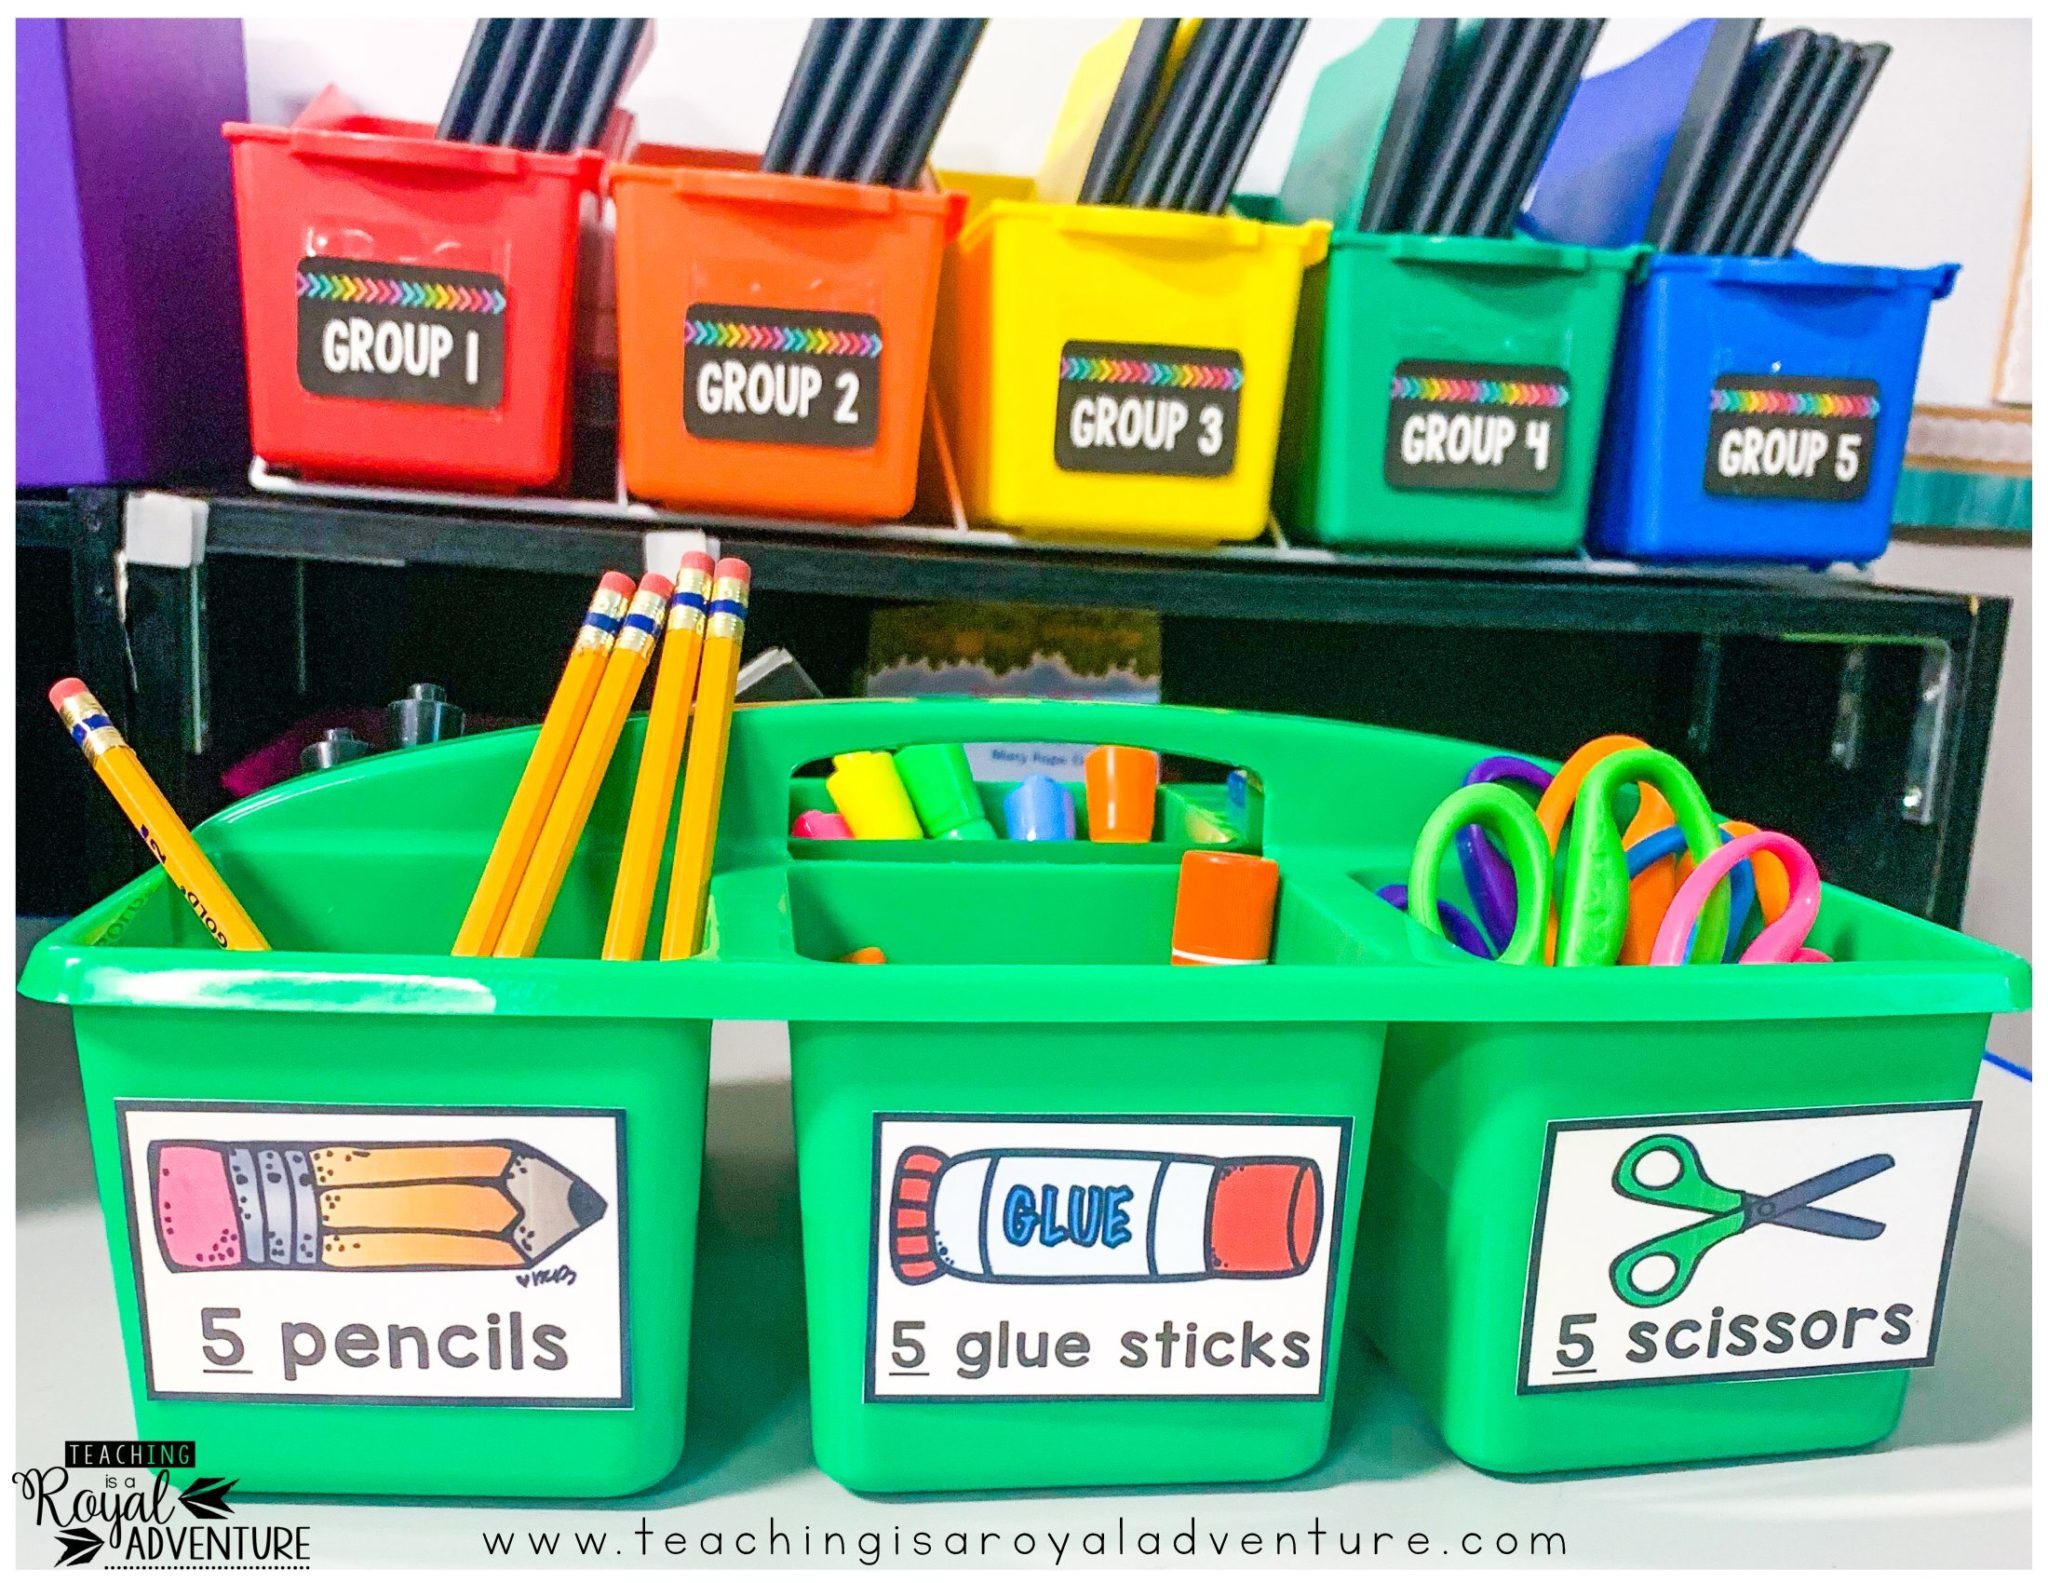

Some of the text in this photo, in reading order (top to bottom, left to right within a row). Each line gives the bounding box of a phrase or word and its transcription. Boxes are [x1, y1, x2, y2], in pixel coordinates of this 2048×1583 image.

[322, 316, 479, 385] GROUP 1
[696, 359, 860, 425] GROUP 2
[1069, 395, 1224, 457] GROUP 3
[1400, 411, 1551, 472] GROUP 4
[1718, 425, 1862, 483] GROUP 5
[1003, 1184, 1134, 1249] GLUE
[201, 1307, 569, 1381] 5 pencils
[891, 1320, 1310, 1380] 5 glue sticks
[1556, 1302, 1914, 1368] 5 scissors
